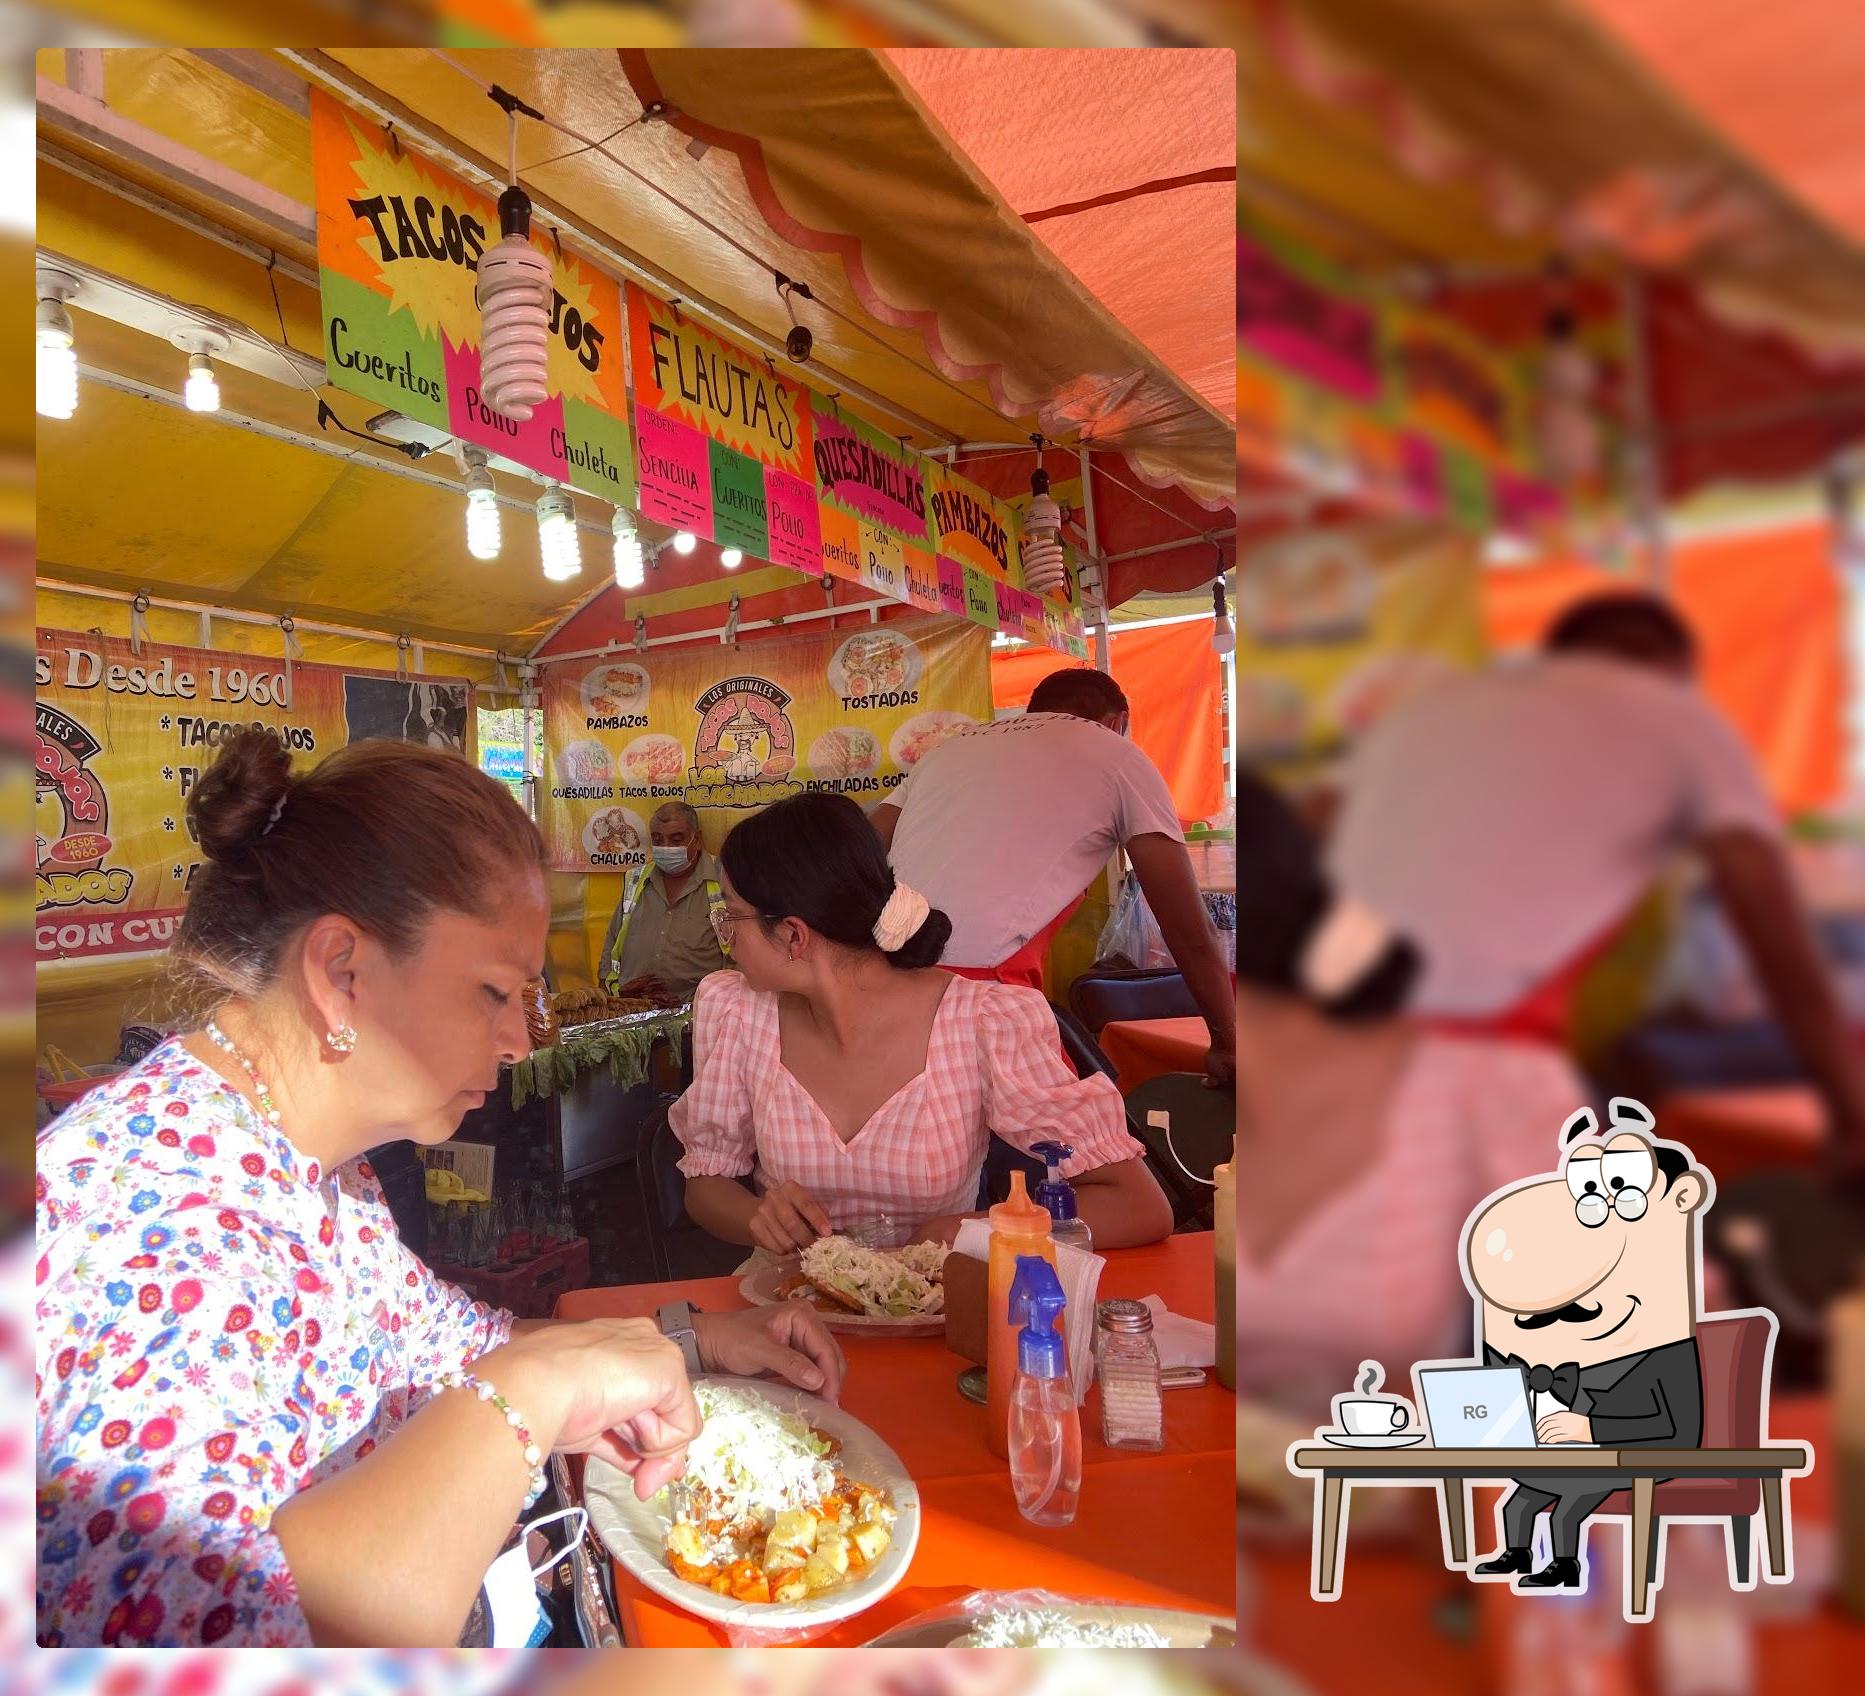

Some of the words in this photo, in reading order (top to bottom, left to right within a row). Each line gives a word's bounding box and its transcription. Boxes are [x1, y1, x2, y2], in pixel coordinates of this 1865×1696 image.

[348, 196, 485, 272] TACOS
[330, 317, 442, 403] Cueritos
[648, 321, 793, 451] FLAUTAS
[550, 425, 620, 485] Chuleta
[814, 437, 926, 521] QUESADILLAS
[931, 491, 1008, 571] PAMBAZOS
[869, 551, 894, 585] Pollo
[904, 565, 938, 602] Chuleta
[63, 647, 197, 700] Desde
[208, 666, 288, 709] 1960
[708, 688, 723, 703] LOS
[726, 680, 774, 699] ORIGINALES
[841, 689, 919, 711] TOSTADAS
[587, 714, 649, 731] PAMBAZOS
[552, 786, 614, 799] QUESADILLAS
[619, 786, 648, 798] TACOS
[650, 785, 684, 798] ROJOS
[806, 776, 879, 793] ENCHILADAS
[64, 835, 97, 850] DESDE
[69, 847, 99, 861] 1960
[590, 852, 646, 865] CHALUPAS
